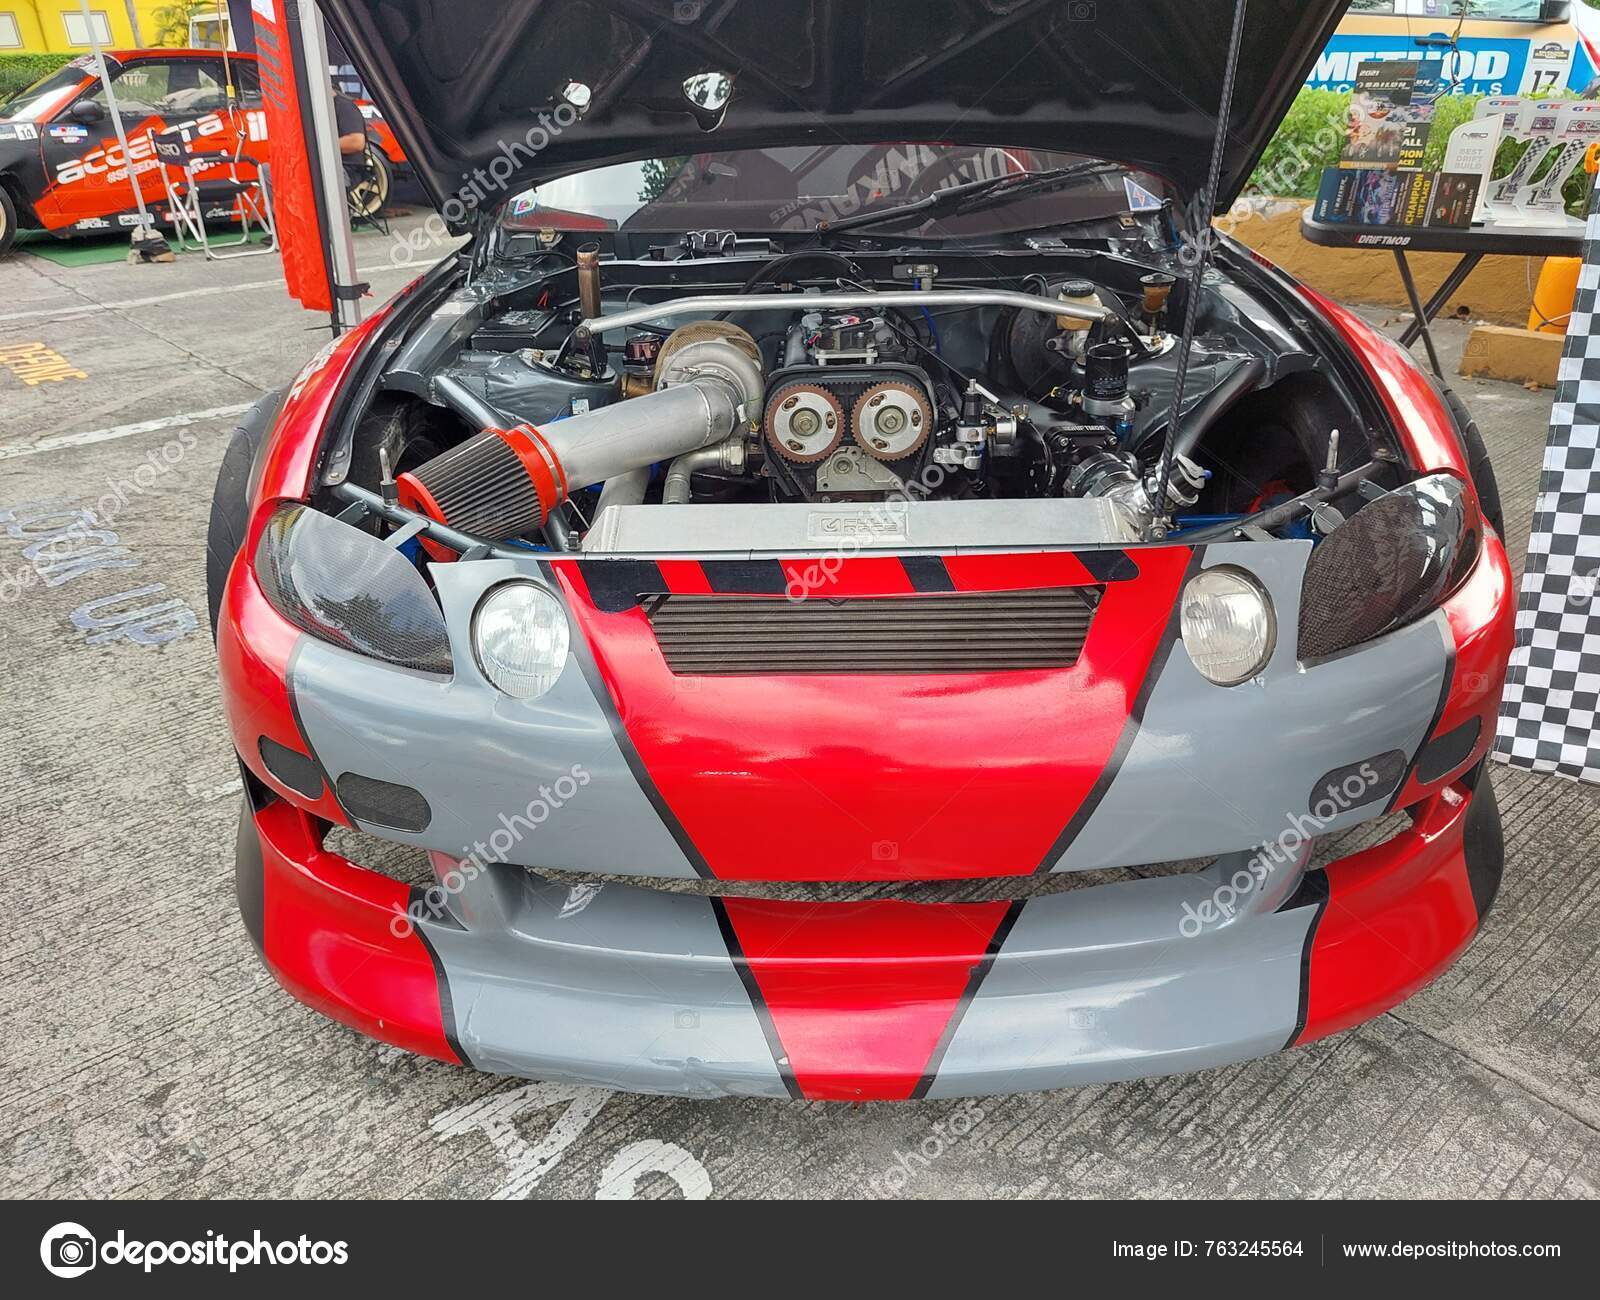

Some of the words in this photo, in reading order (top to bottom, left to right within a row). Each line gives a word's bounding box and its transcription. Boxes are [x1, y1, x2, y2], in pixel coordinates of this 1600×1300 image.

[1533, 71, 1560, 93] 17
[1403, 126, 1417, 137] 21
[1400, 149, 1424, 159] PION
[1404, 173, 1425, 225] CHAMPION
[69, 582, 199, 646] UP
